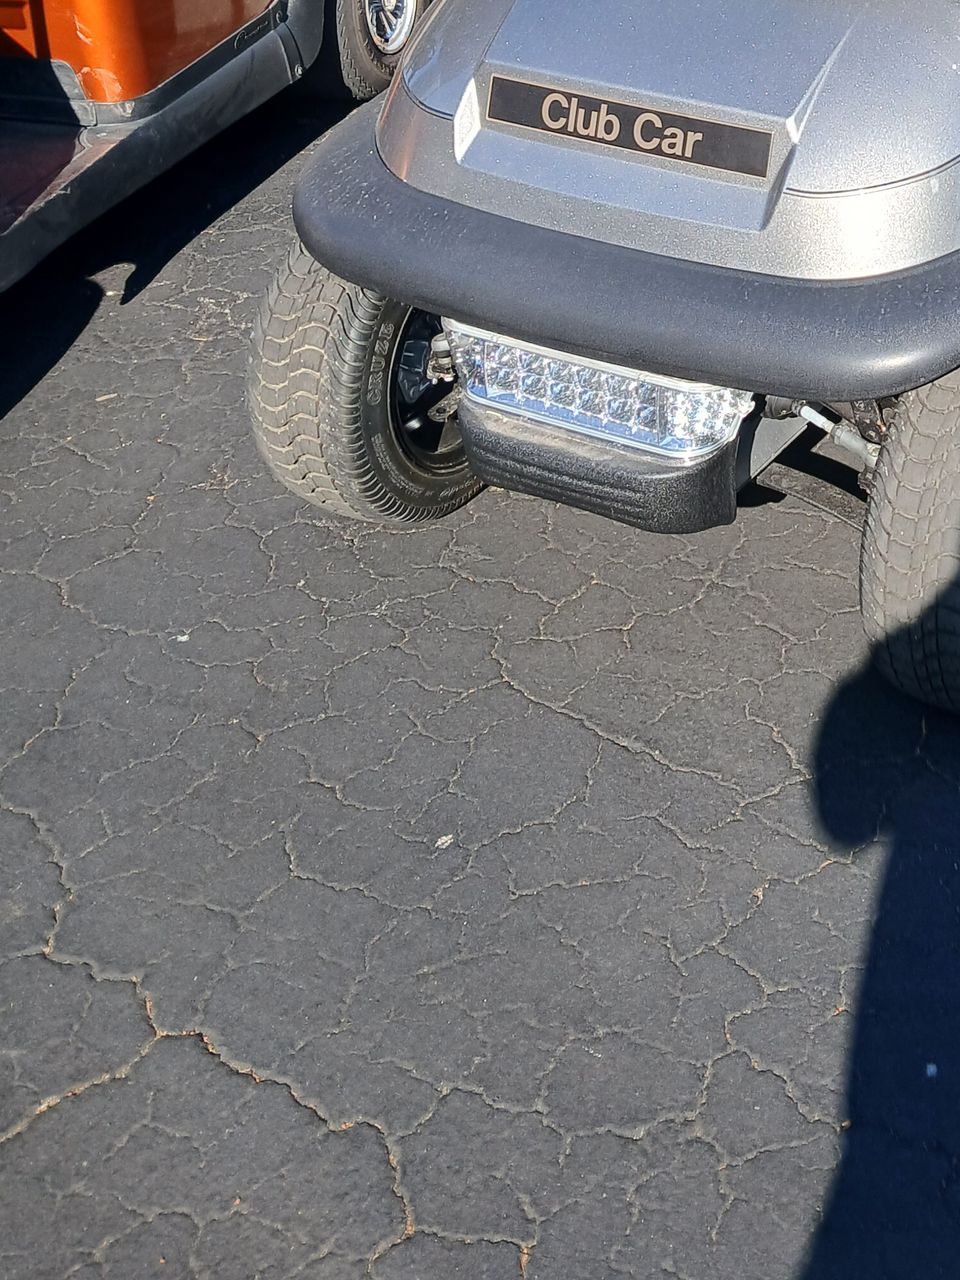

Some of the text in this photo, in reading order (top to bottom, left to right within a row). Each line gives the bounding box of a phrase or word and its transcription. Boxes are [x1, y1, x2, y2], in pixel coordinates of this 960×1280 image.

[541, 92, 703, 158] Club Car
[367, 323, 395, 406] CRUZE
